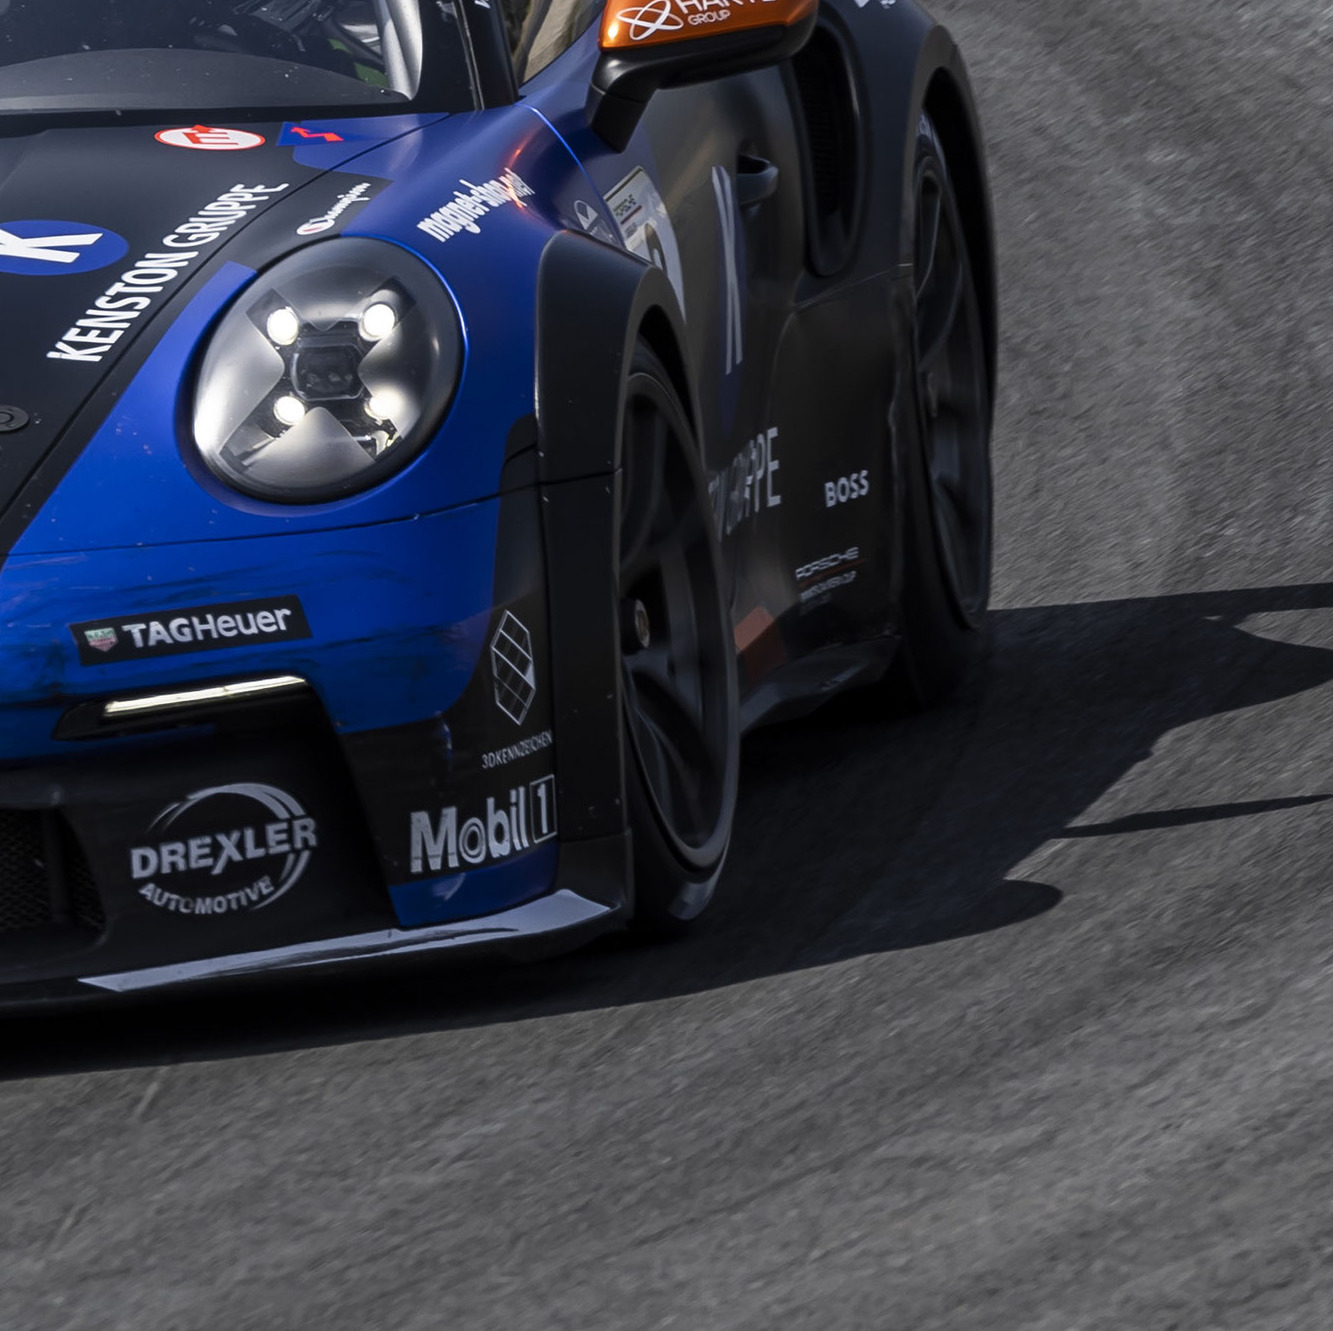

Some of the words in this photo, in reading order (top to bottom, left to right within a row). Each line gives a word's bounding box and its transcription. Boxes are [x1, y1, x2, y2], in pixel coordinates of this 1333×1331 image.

[687, 9, 731, 26] GROUP
[46, 243, 192, 363] KENSTON
[164, 182, 290, 259] GRUPPE
[824, 469, 869, 508] BOSS
[122, 608, 292, 650] TAGHeuer
[131, 817, 317, 880] DREXLER
[410, 785, 530, 874] Mobil
[139, 875, 275, 915] AUTOMOTIVE
